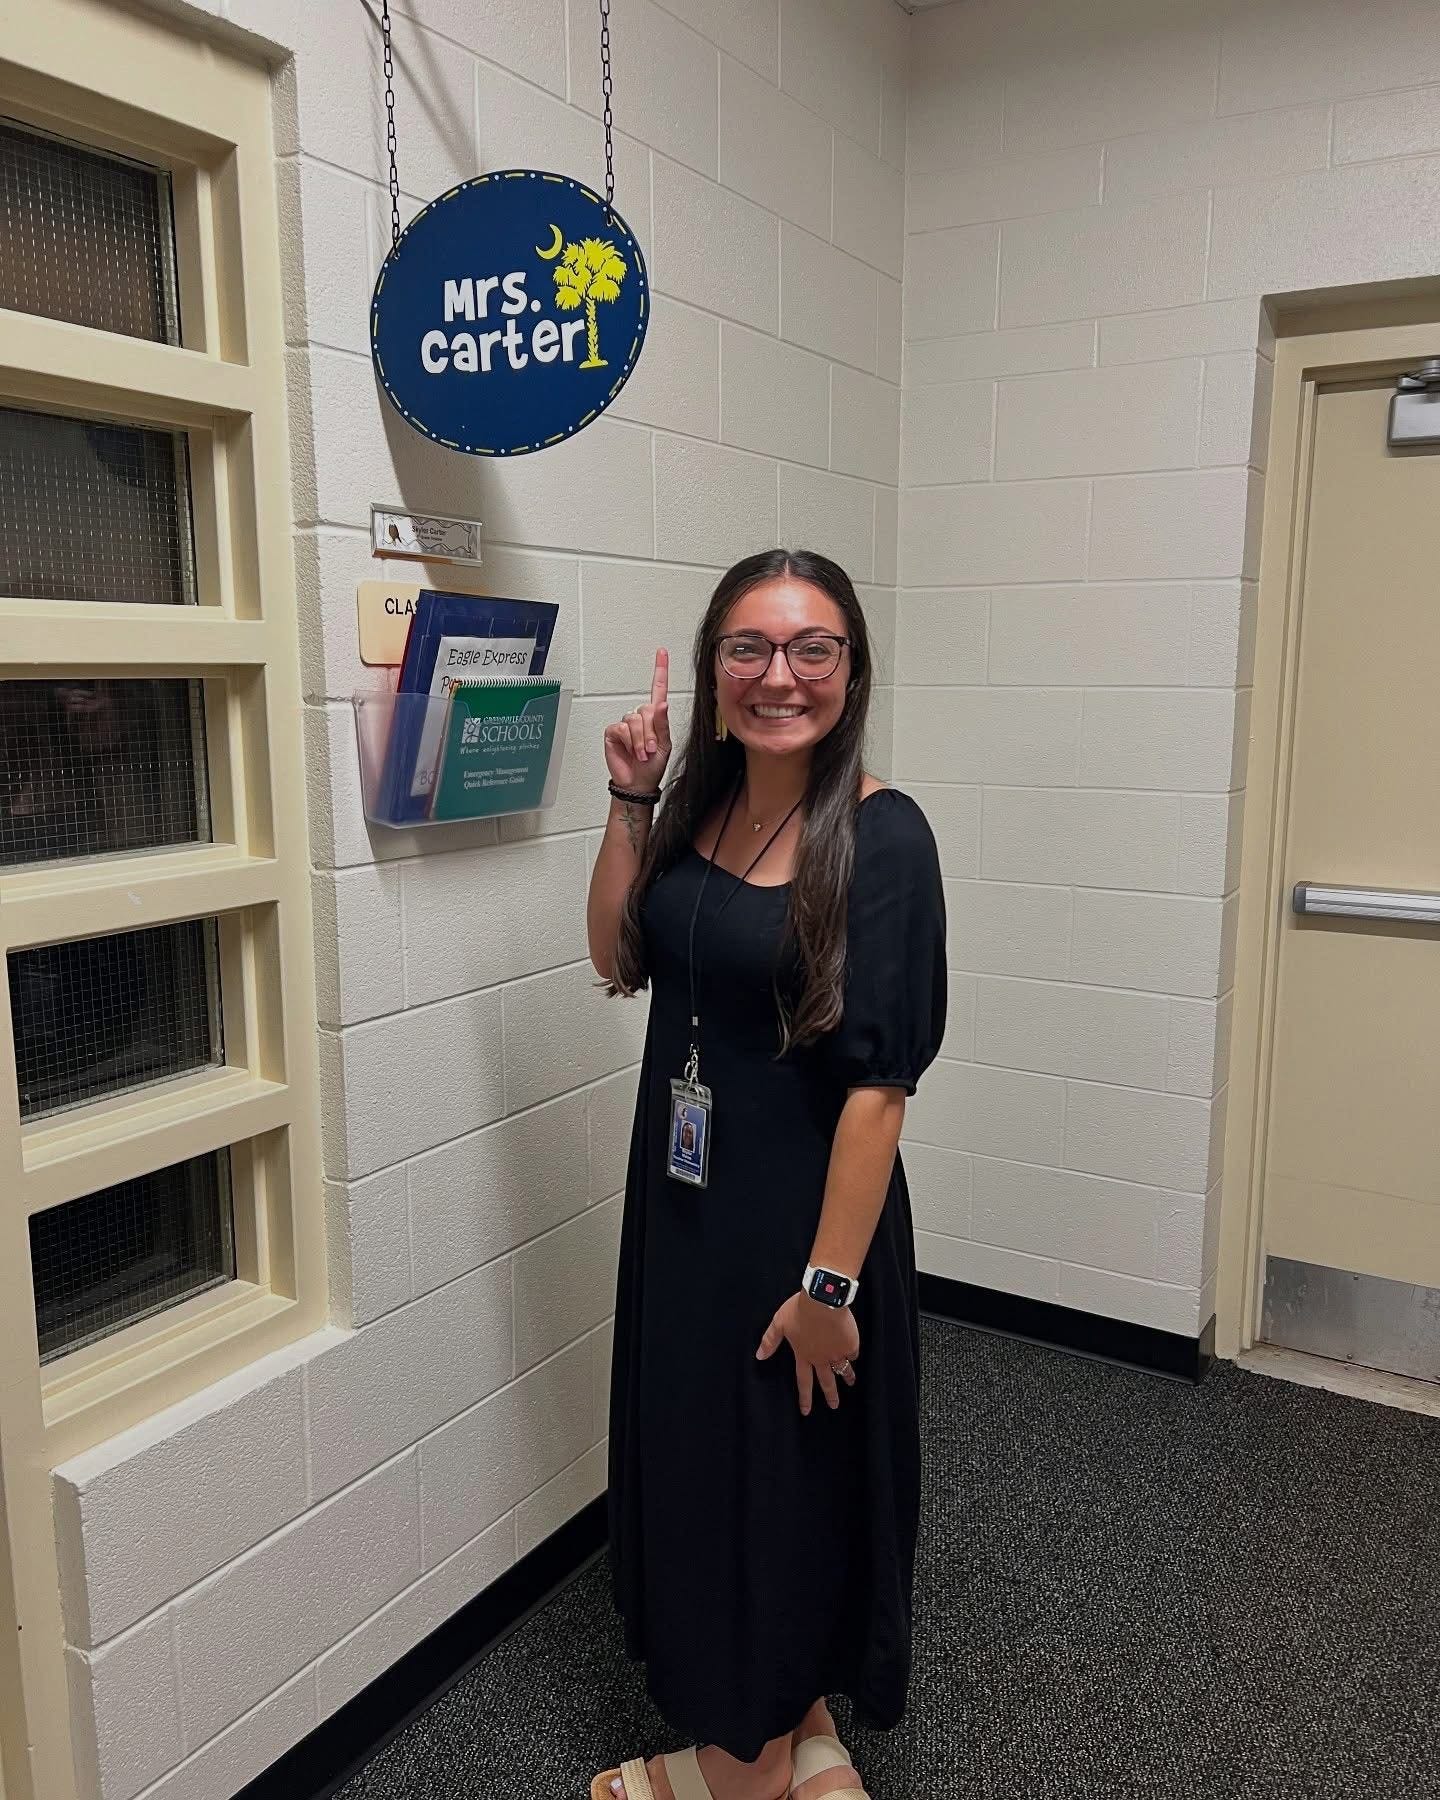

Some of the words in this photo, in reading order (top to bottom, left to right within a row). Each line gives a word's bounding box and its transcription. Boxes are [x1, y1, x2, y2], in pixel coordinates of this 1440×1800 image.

[444, 271, 541, 322] Mrs.
[447, 648, 480, 666] Eagle
[482, 649, 528, 666] Express
[520, 714, 544, 724] COUNTY
[480, 723, 544, 743] SCHOOLS
[464, 780, 480, 790] Quick
